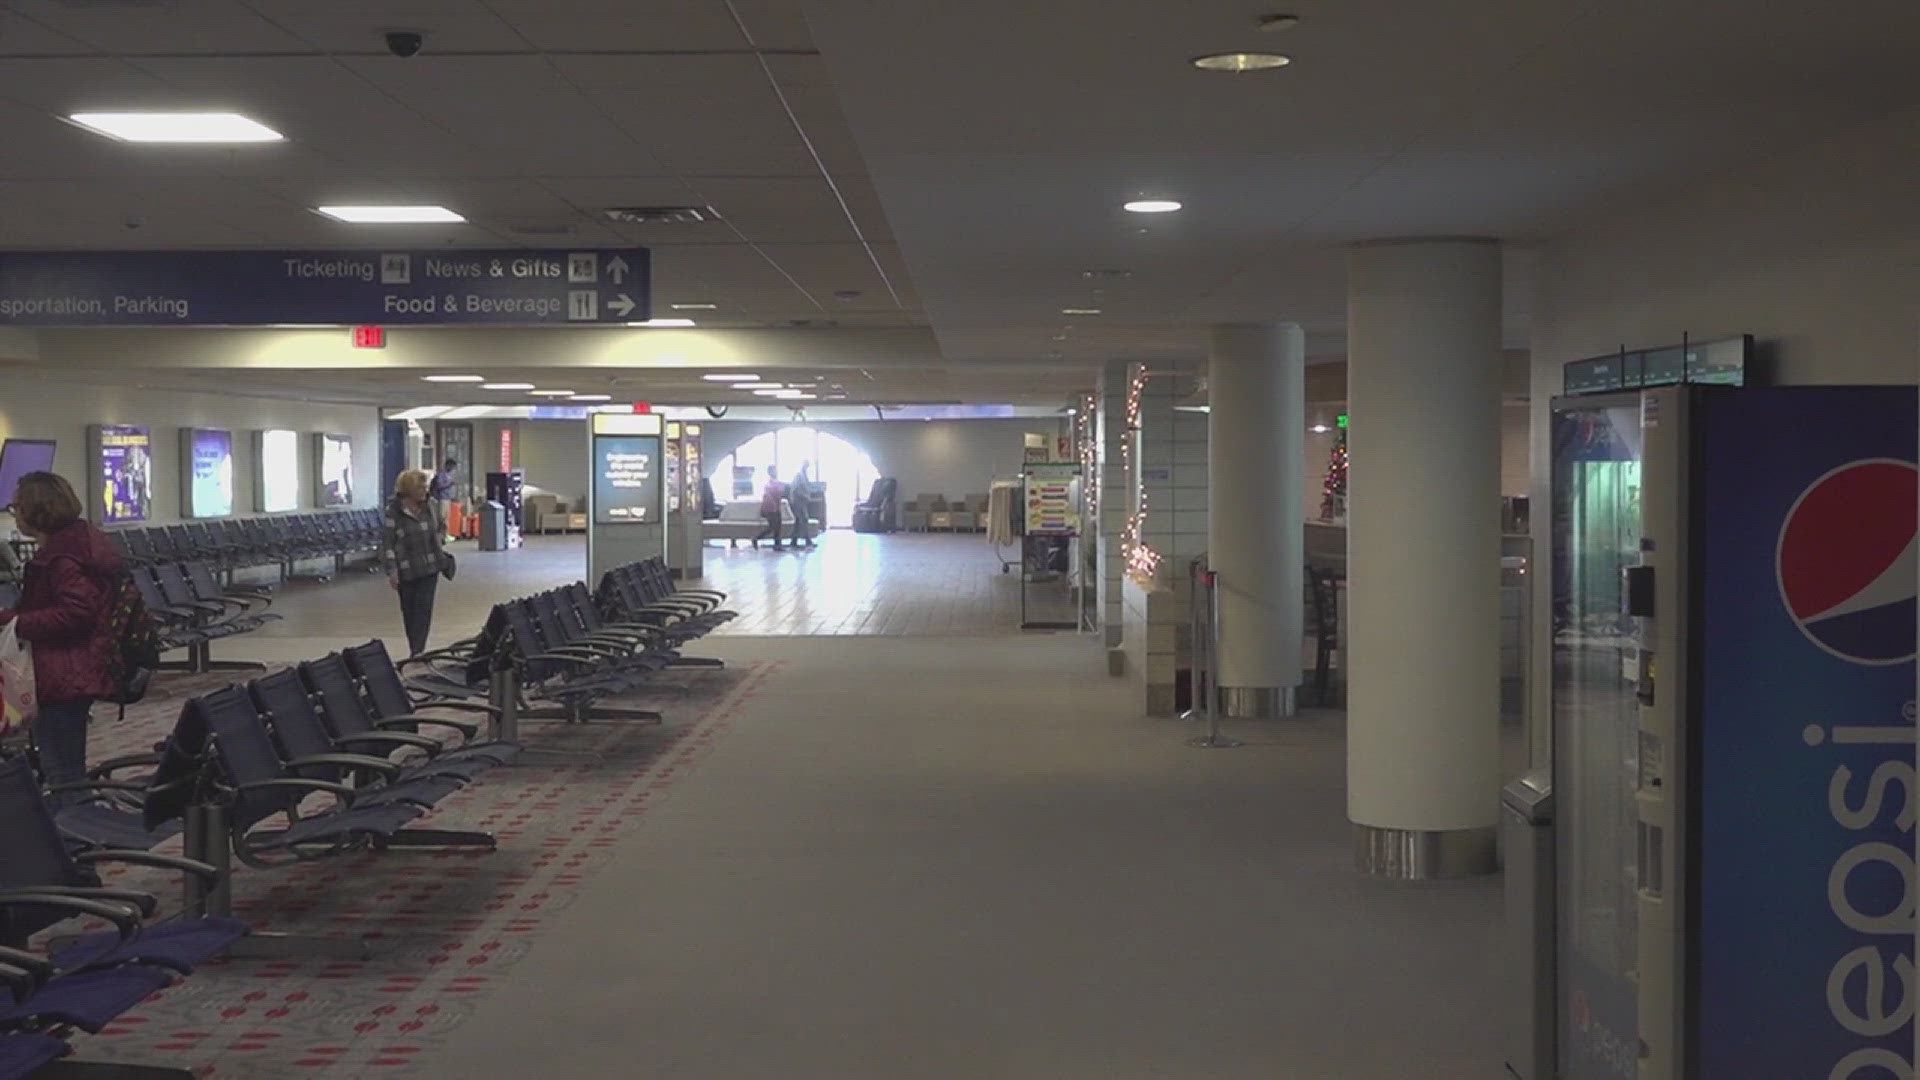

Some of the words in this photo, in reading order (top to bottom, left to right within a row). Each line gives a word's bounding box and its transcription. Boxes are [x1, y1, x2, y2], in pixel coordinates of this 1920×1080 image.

[284, 258, 374, 282] Ticketing
[425, 259, 482, 278] News
[489, 258, 504, 278] &
[511, 258, 561, 278] Gifts
[114, 295, 189, 318] Parking
[384, 295, 436, 314] Food
[443, 295, 458, 313] &
[466, 294, 561, 317] Beverage
